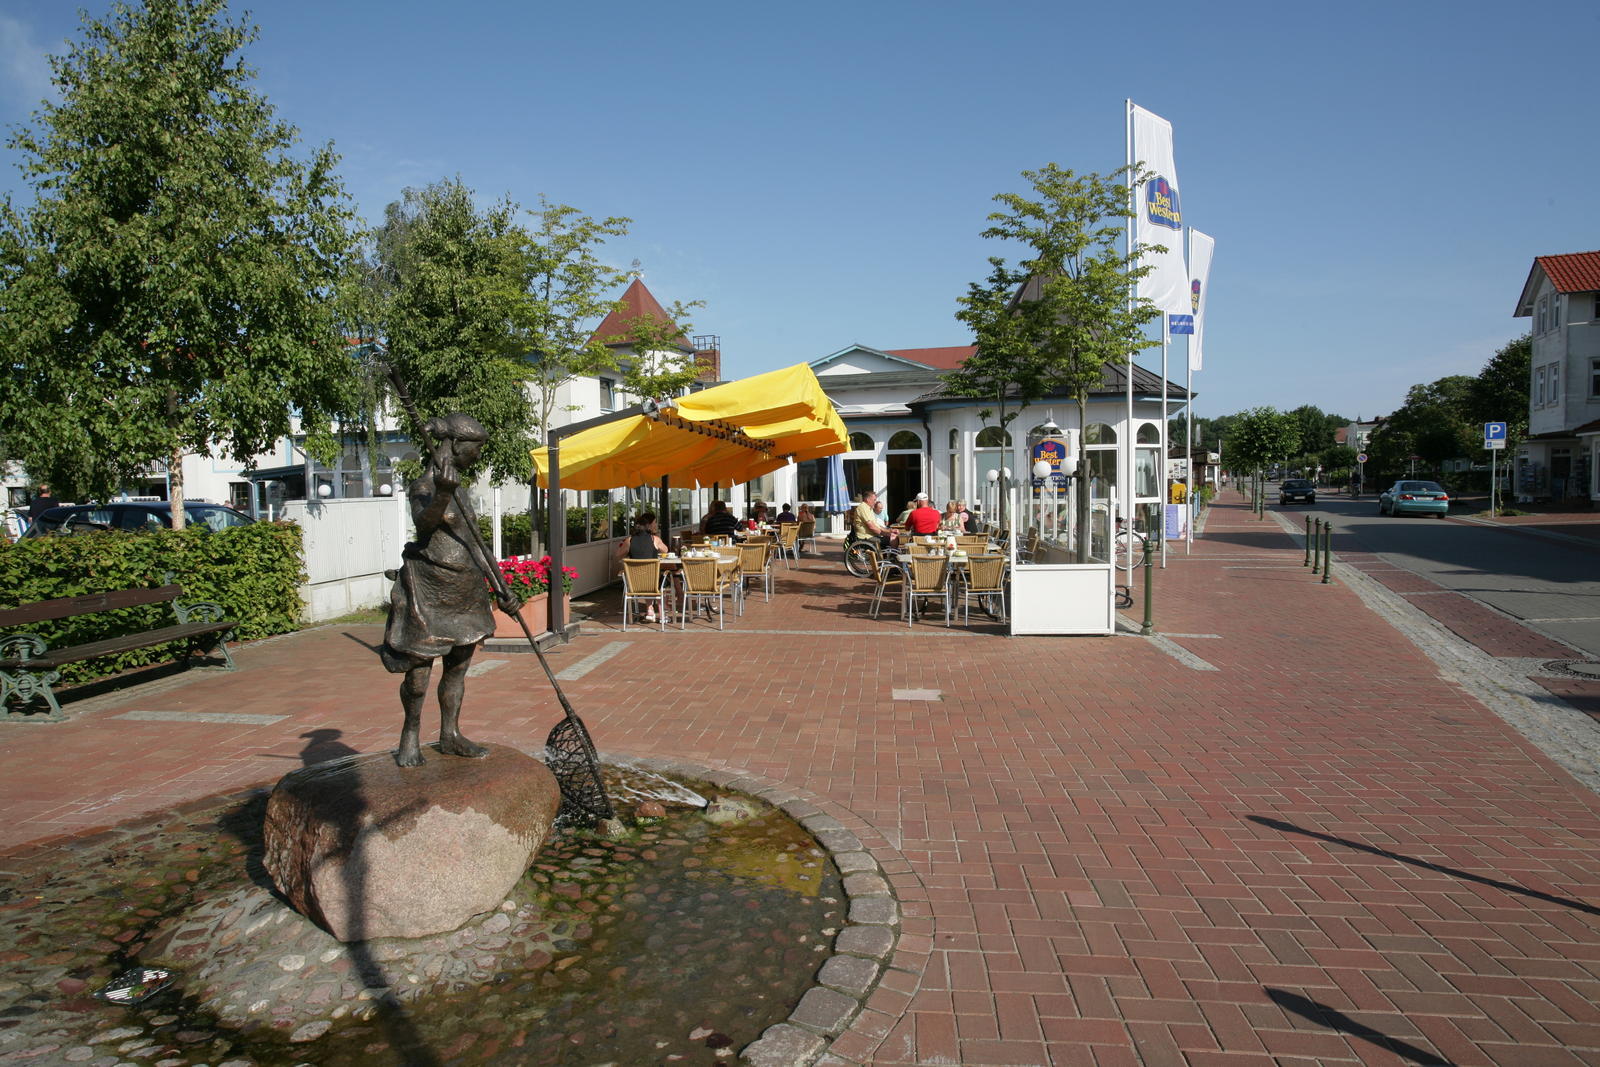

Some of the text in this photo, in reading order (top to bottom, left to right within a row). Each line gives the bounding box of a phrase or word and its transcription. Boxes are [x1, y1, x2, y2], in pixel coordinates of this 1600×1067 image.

[1154, 192, 1171, 207] Best
[1148, 202, 1180, 222] Western
[1490, 425, 1501, 438] P
[1040, 451, 1058, 459] Best
